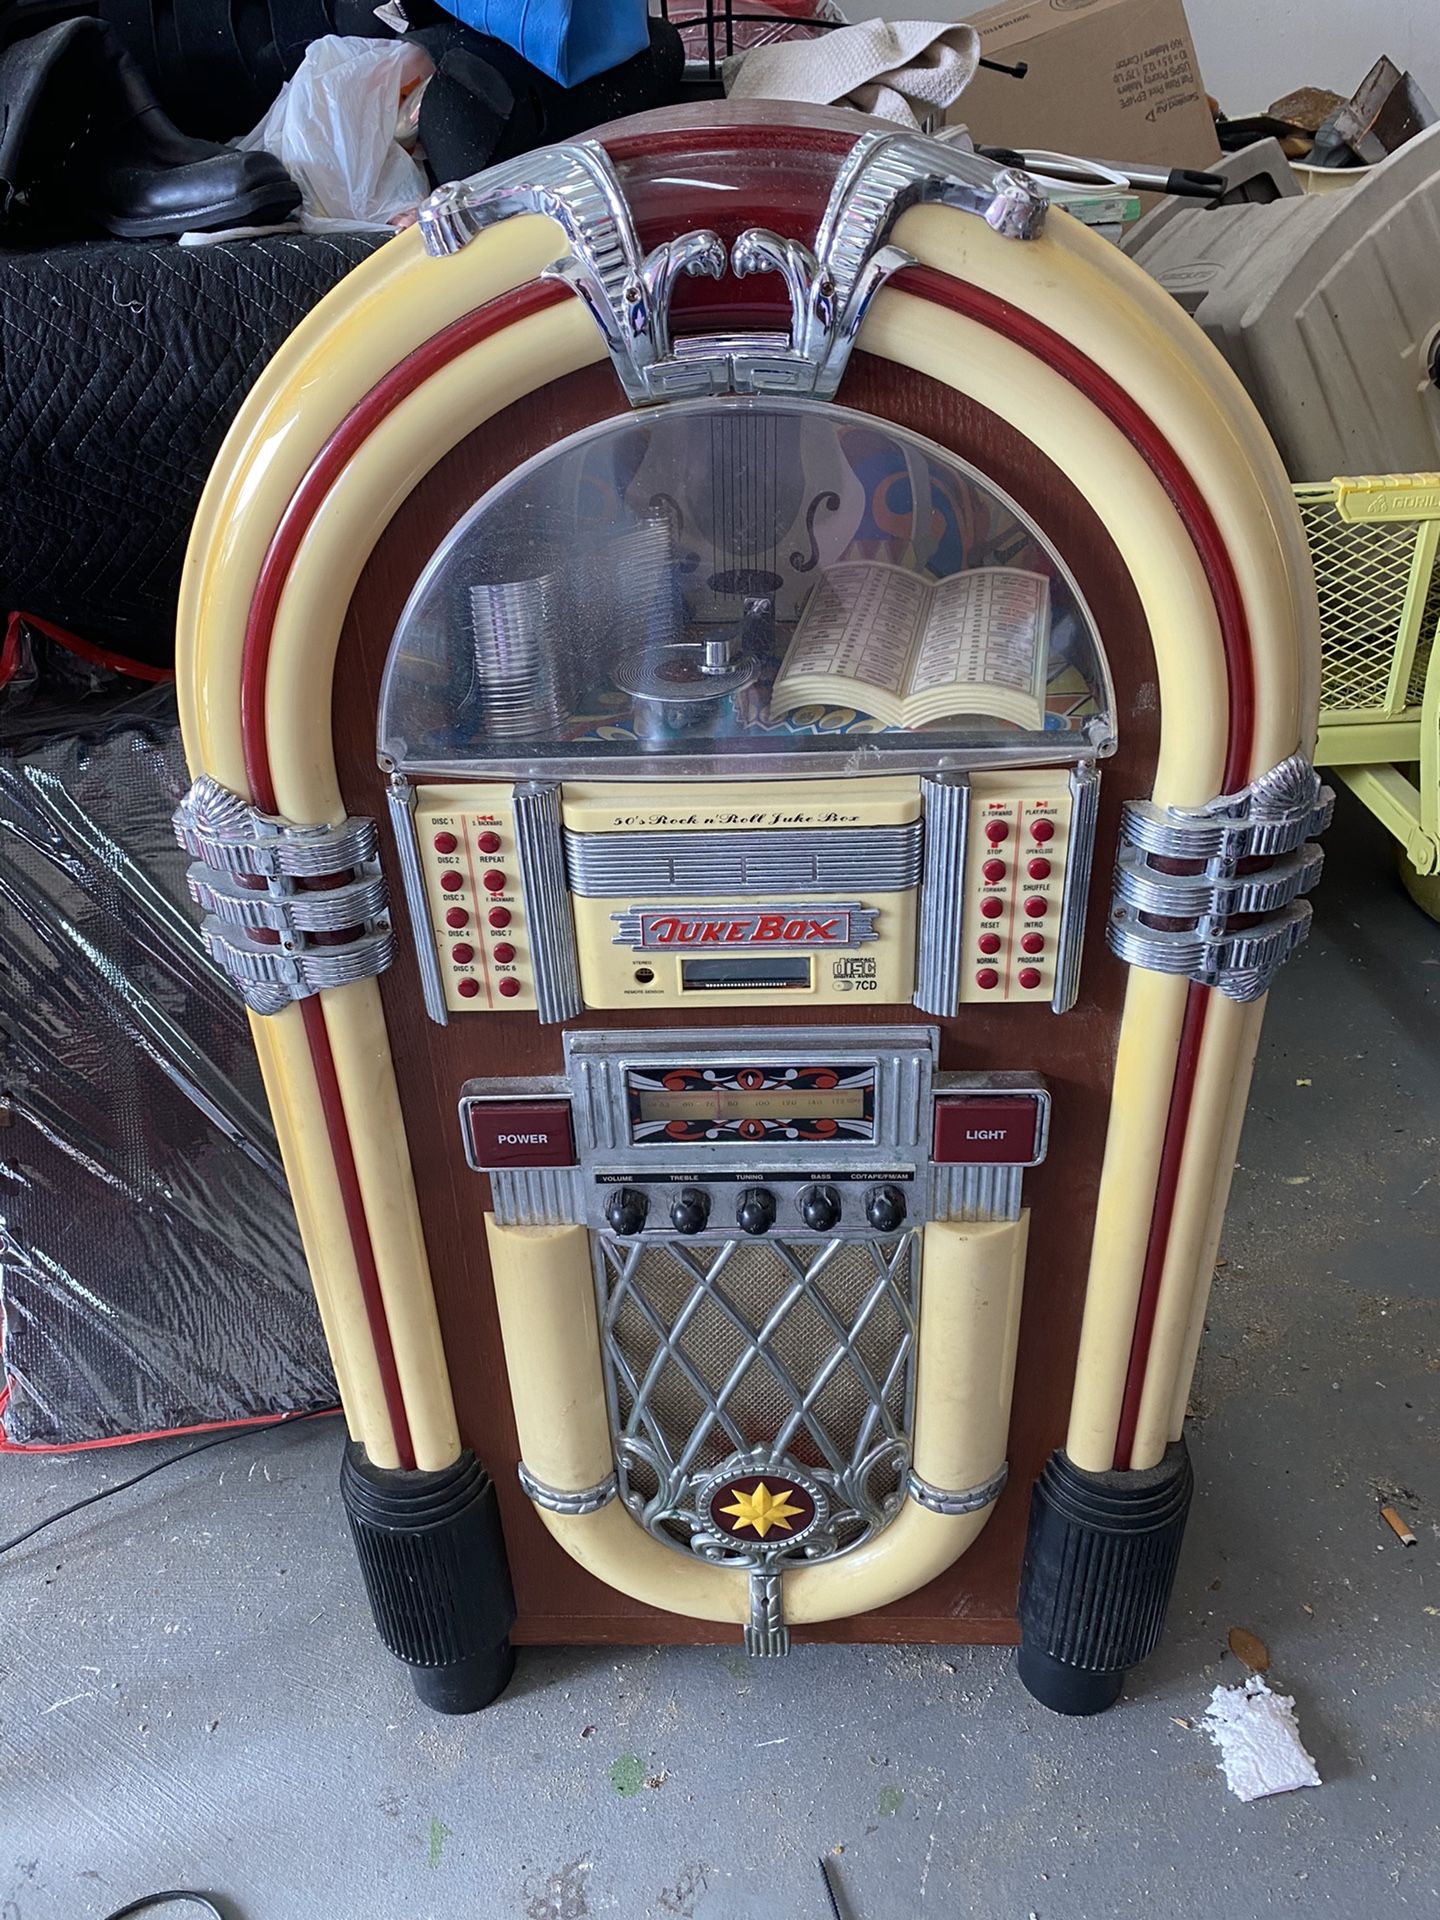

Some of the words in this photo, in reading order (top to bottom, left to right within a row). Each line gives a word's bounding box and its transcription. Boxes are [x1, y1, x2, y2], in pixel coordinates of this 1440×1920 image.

[1144, 44, 1170, 58] Mailers
[1116, 55, 1140, 69] Carton
[1169, 60, 1191, 77] USPS
[1144, 70, 1169, 84] Priority
[613, 815, 646, 826] 50's
[648, 814, 698, 825] Rock
[768, 812, 813, 826] Juke
[817, 812, 860, 822] Box
[1022, 884, 1050, 892] SHUFFLE
[855, 980, 878, 990] 7CD
[498, 1133, 548, 1145] POWER
[965, 1129, 1007, 1141] LIGHT
